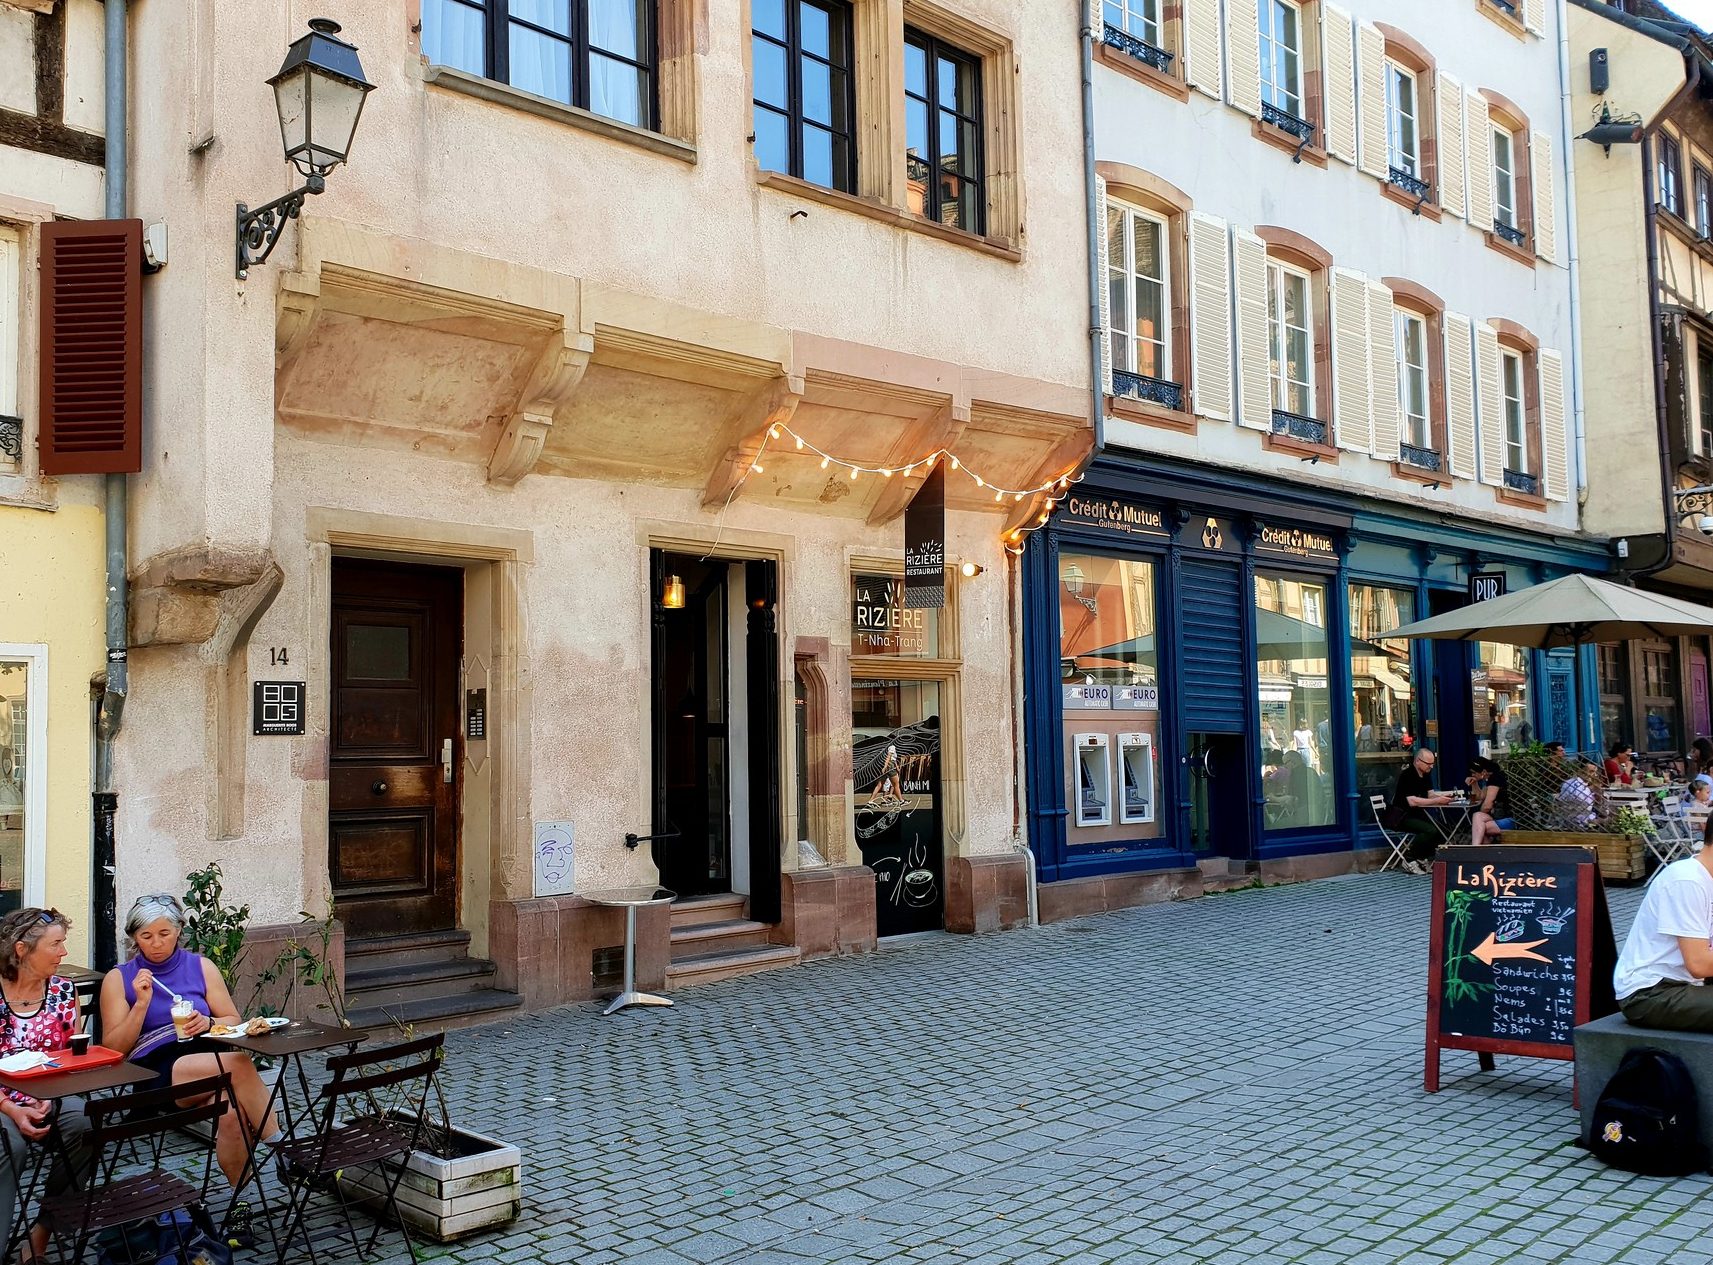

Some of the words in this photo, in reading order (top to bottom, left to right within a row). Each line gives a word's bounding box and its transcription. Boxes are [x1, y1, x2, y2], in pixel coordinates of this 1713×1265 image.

[1069, 498, 1107, 519] Crédit
[1123, 506, 1162, 527] Mutuel
[1098, 518, 1131, 533] Gutenberg
[1261, 527, 1291, 546] Crédit
[1303, 533, 1333, 552] Mutuel
[906, 552, 943, 566] RIZIÈRE
[906, 567, 943, 576] RESTAURANT
[857, 589, 871, 602] LA
[1476, 579, 1498, 600] PUR
[857, 603, 923, 629] RIZIÈRE
[269, 647, 290, 666] 14
[1084, 688, 1109, 699] EURO
[1133, 689, 1157, 700] EURO
[1457, 865, 1480, 886] La
[1491, 899, 1535, 908] Restaurant
[1492, 963, 1559, 980] Sandwichs
[1494, 977, 1536, 996] Soupes
[1494, 993, 1526, 1008] Nems
[1493, 1005, 1546, 1026] Salades
